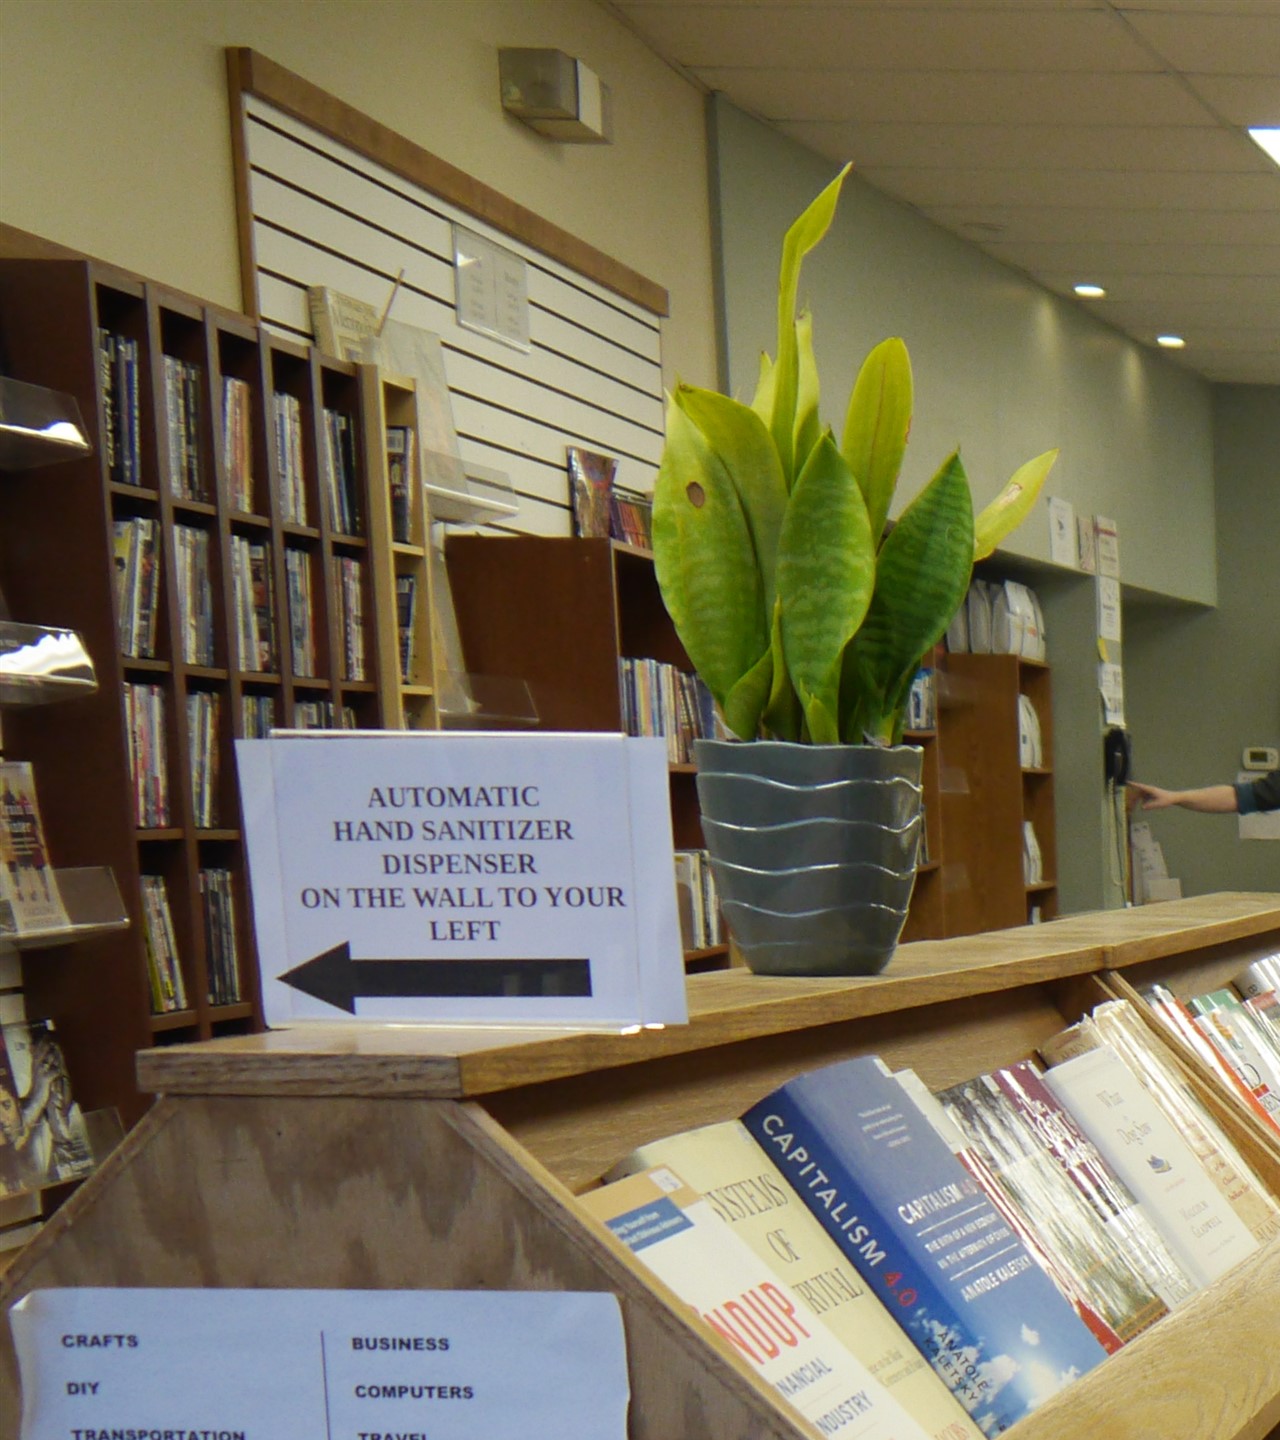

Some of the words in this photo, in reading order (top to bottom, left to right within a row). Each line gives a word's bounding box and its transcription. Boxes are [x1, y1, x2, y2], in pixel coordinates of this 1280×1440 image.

[368, 786, 540, 809] AUTOMATIC
[333, 820, 414, 842] HAND
[421, 819, 574, 841] SANITIZER
[382, 853, 538, 875] DISPENSER
[301, 887, 342, 909] ON
[347, 887, 405, 909] THE
[413, 886, 494, 908] WALL
[498, 887, 538, 908] TO
[538, 886, 626, 908] YOUR
[430, 920, 501, 942] LEFT
[763, 1114, 886, 1267] CAPITALISM
[883, 1270, 918, 1308] 4.0
[898, 1183, 965, 1225] CAPITALISM
[766, 1228, 800, 1264] OF
[792, 1267, 864, 1315] RVIVAL
[961, 1272, 1000, 1303] ANATOLE
[997, 1253, 1034, 1282] KALETSKY
[62, 1334, 139, 1349] CRAFTS
[352, 1337, 450, 1352] BUSINESS
[700, 1281, 811, 1366] NDUP
[775, 1357, 833, 1399] NANCIAL
[922, 1336, 978, 1402] KALETSKY
[937, 1330, 990, 1391] ANATOLE
[67, 1381, 100, 1395] DIY
[355, 1385, 474, 1400] COMPUTERS
